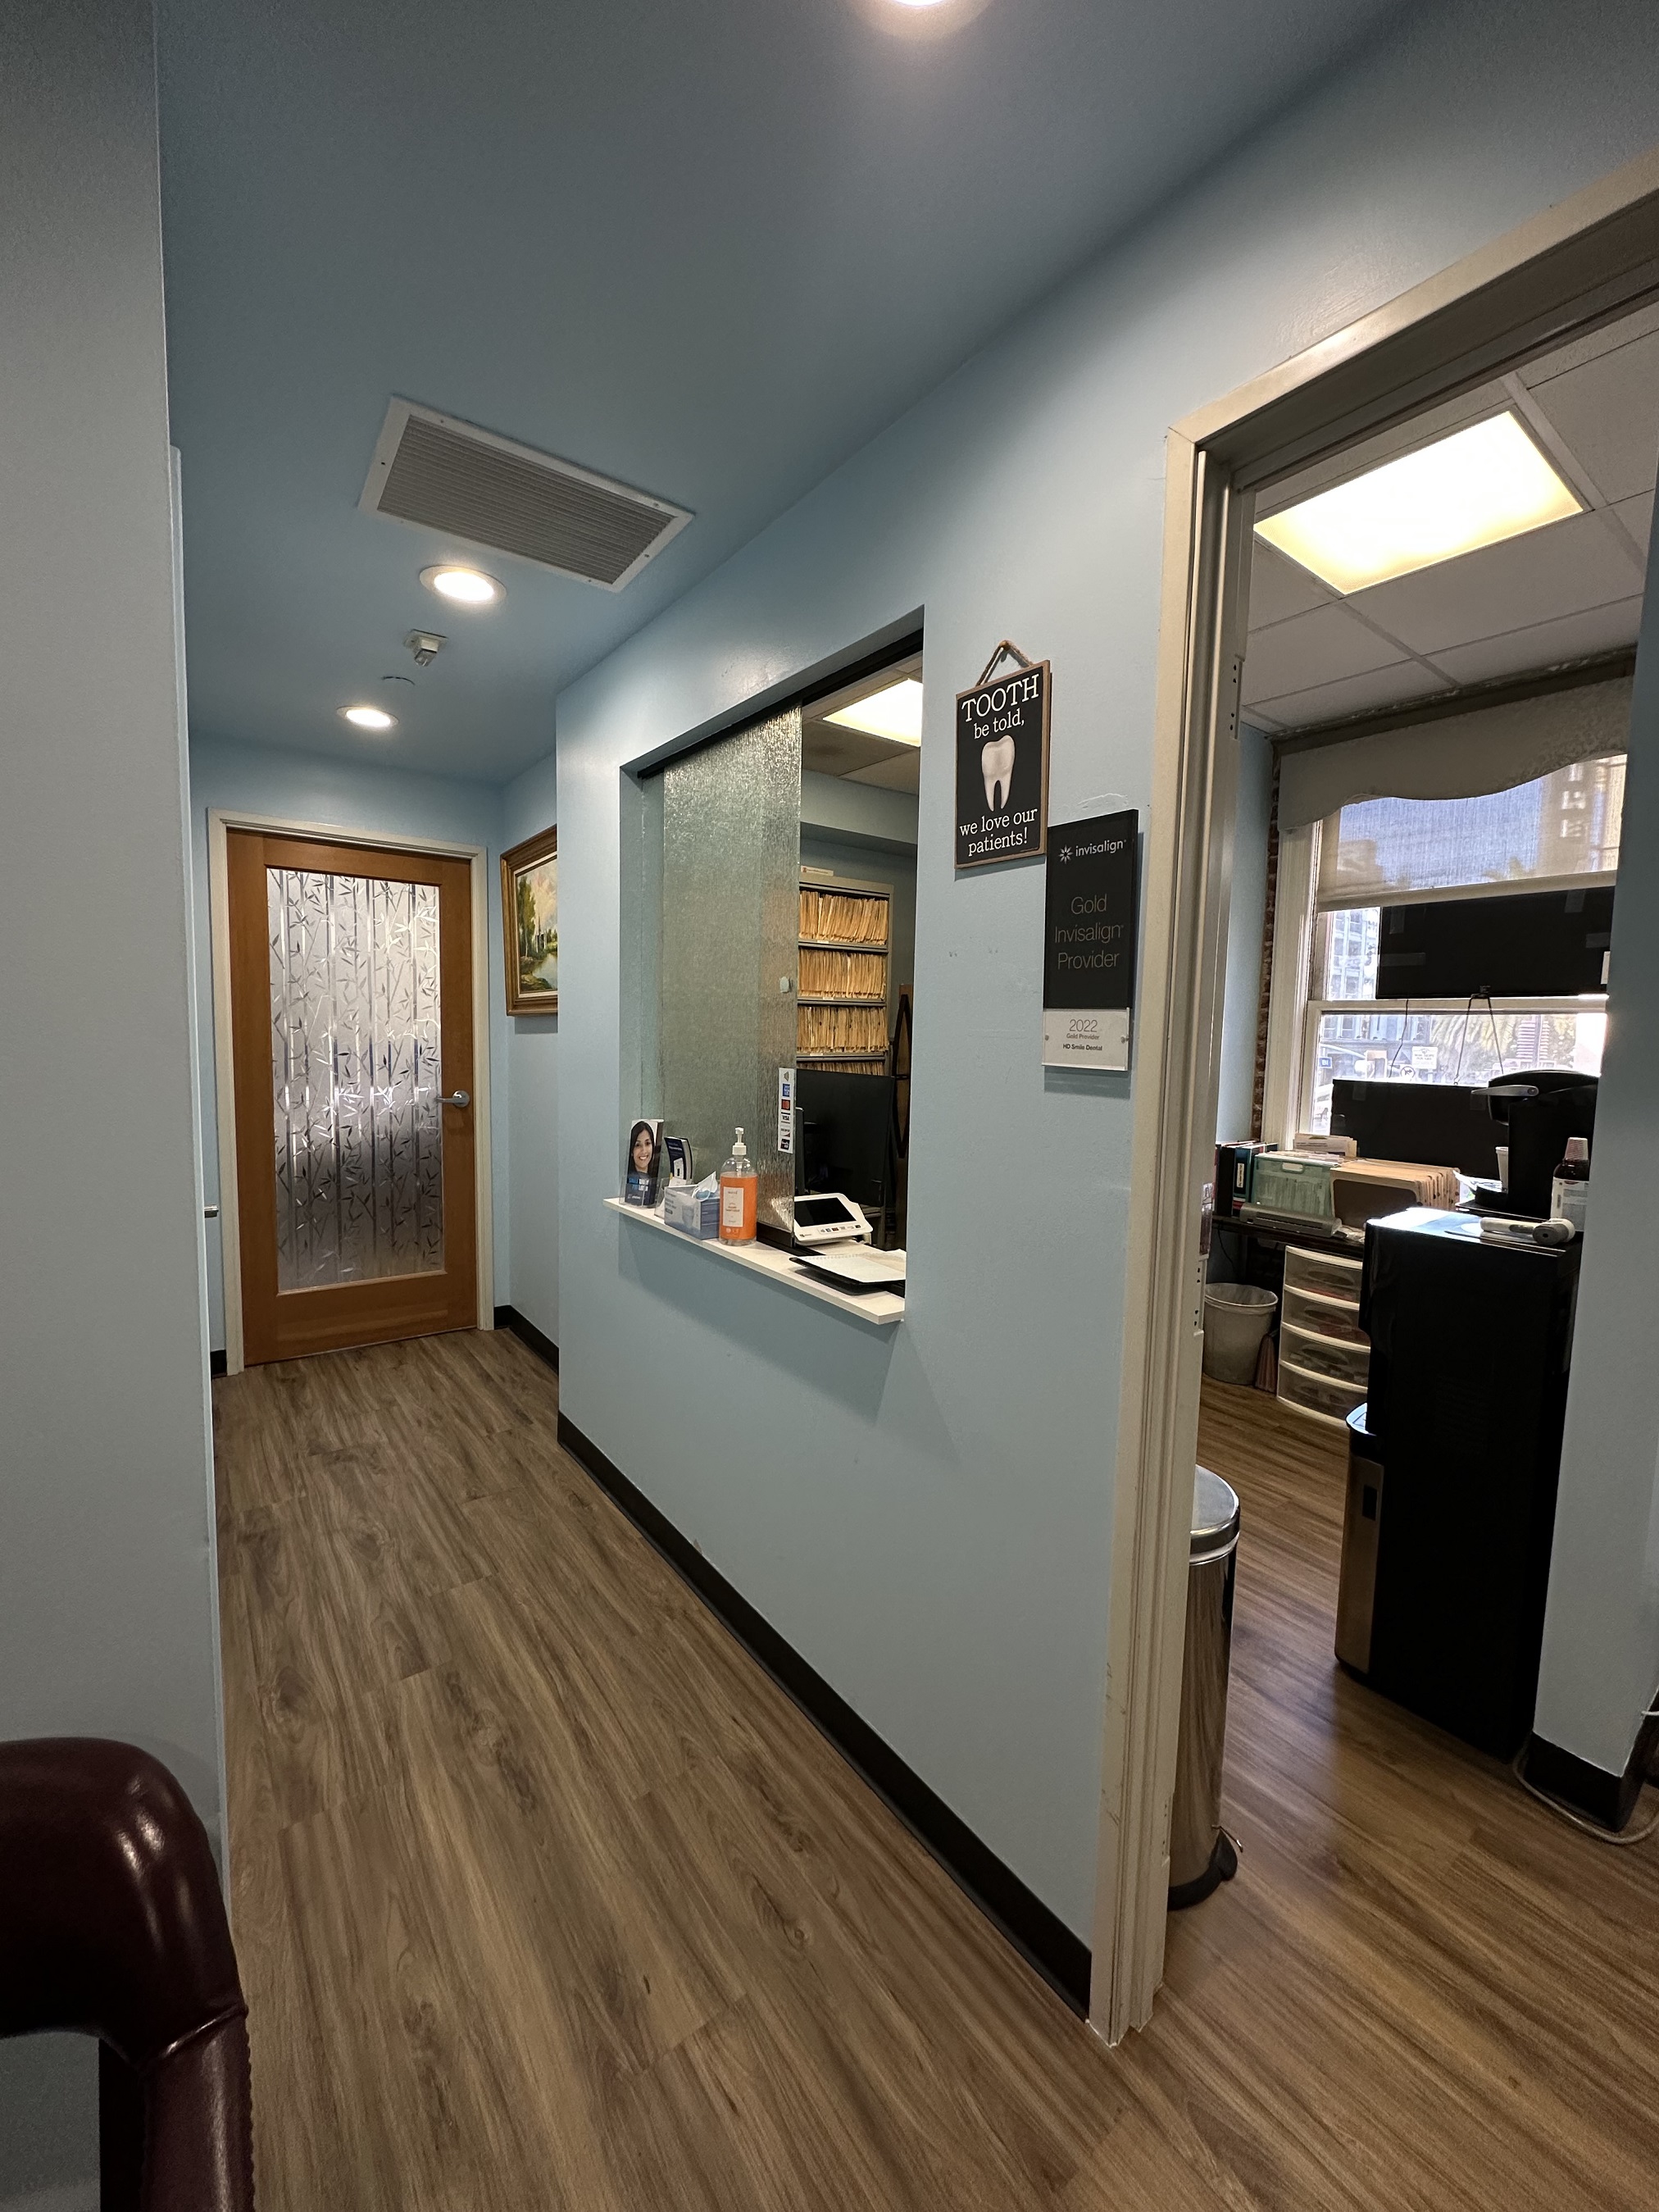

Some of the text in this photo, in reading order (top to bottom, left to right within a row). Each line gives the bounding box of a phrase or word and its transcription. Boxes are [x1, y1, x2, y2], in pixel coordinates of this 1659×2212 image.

[961, 674, 1039, 721] TOOTH
[974, 708, 1025, 739] be told,
[960, 808, 1039, 836] we love our
[968, 826, 1028, 856] patients!
[1075, 839, 1124, 857] invisalign
[1070, 894, 1107, 915] Gold
[1055, 922, 1120, 944] Invisalign
[1057, 950, 1120, 970] Provider
[1069, 1019, 1098, 1032] 2022
